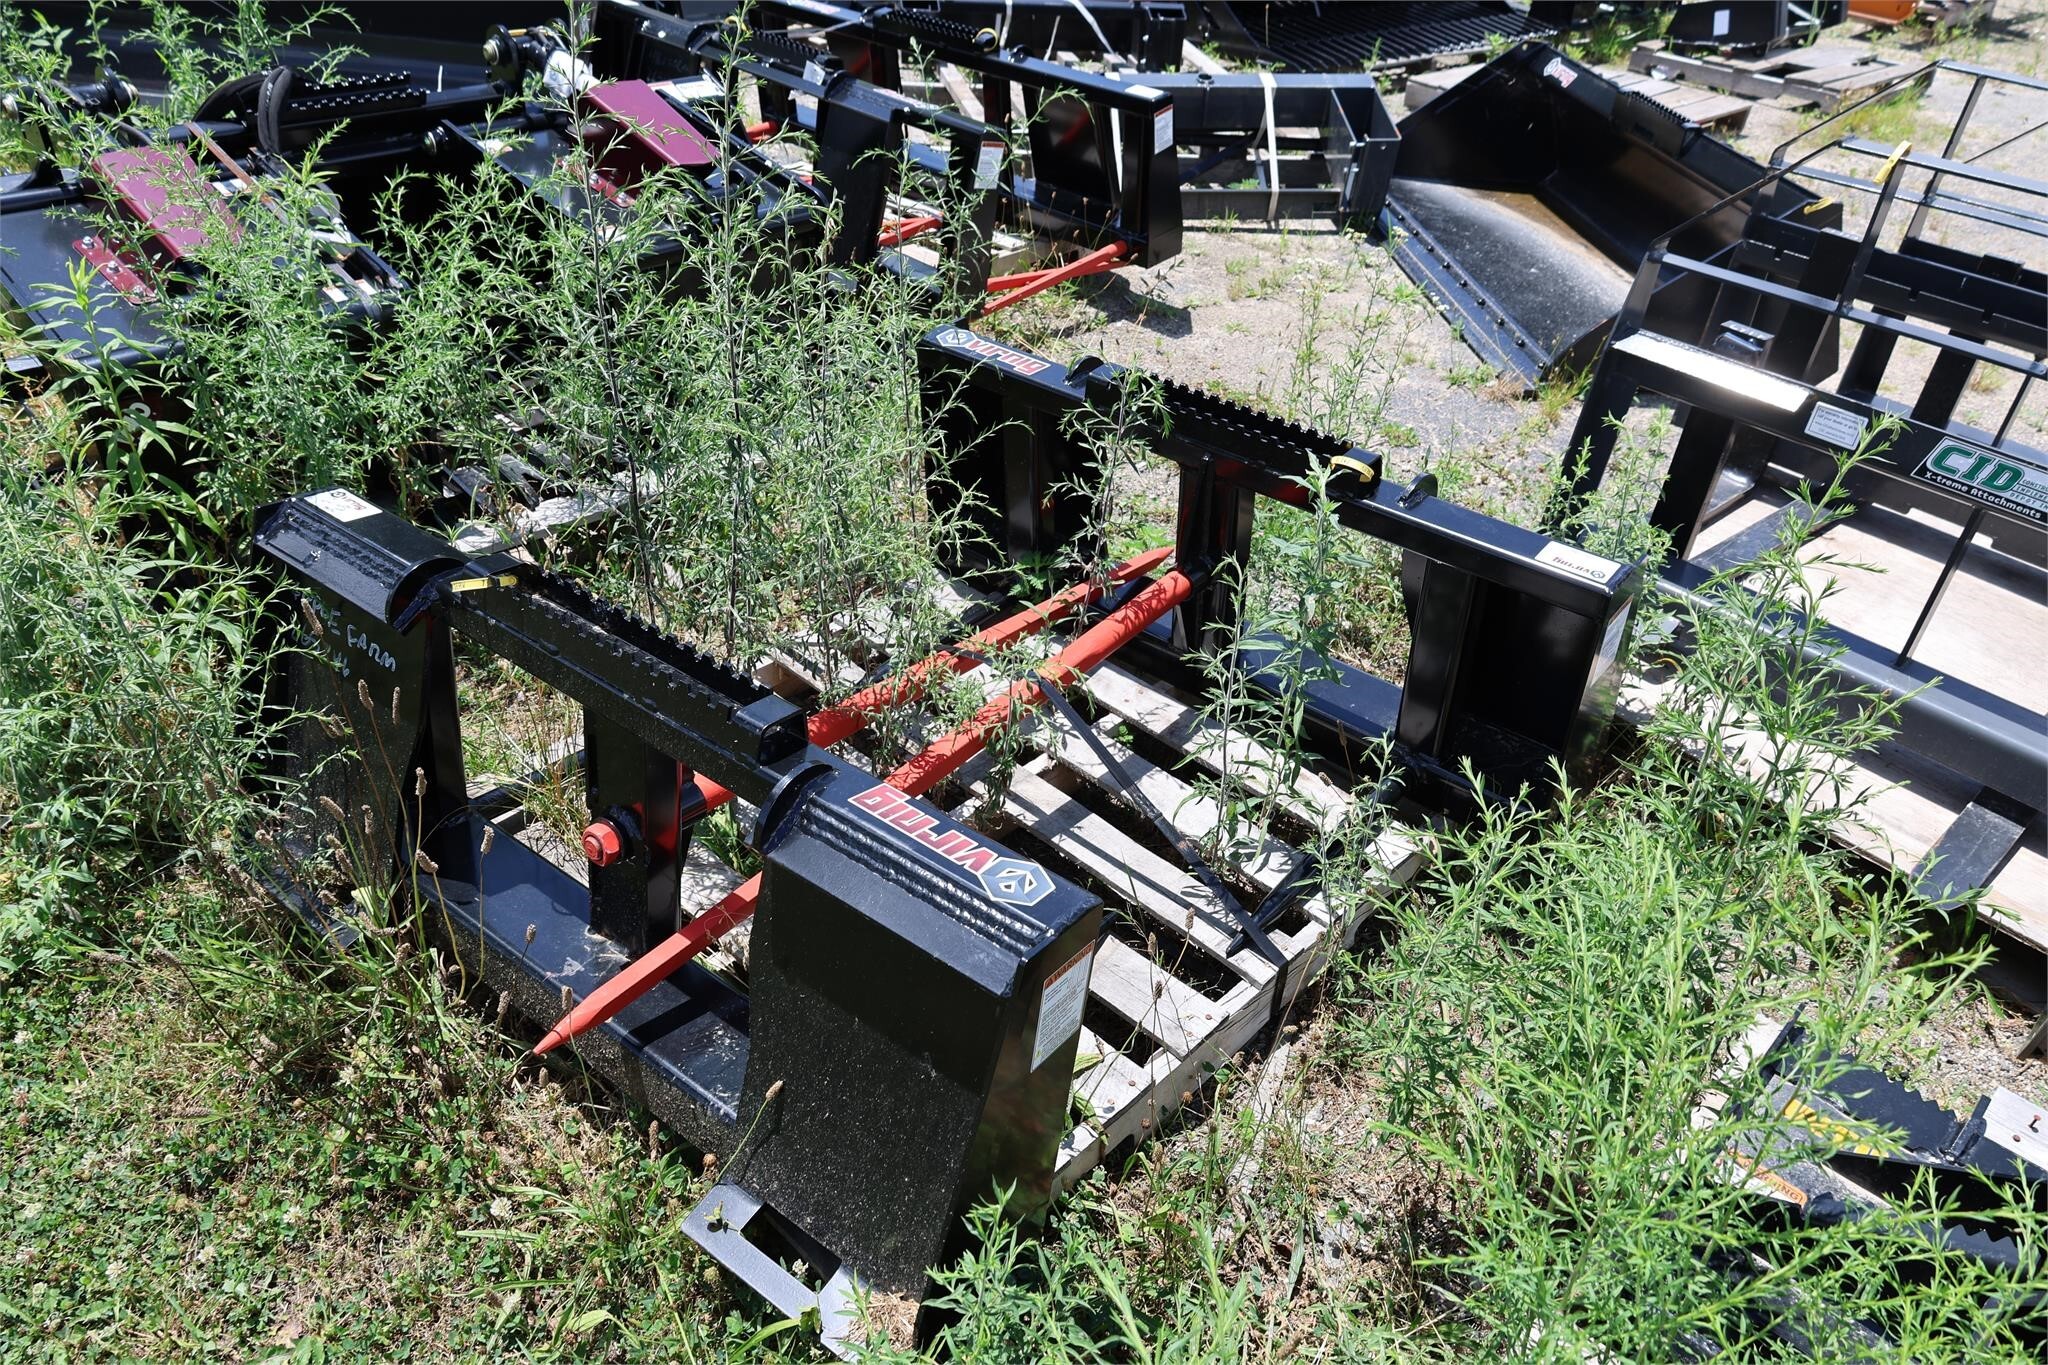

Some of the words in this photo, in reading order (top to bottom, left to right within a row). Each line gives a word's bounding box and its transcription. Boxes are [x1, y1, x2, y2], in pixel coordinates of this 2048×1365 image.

[1931, 445, 2025, 493] CID
[1925, 471, 1968, 492] X-treme
[1970, 488, 2041, 519] Attachments
